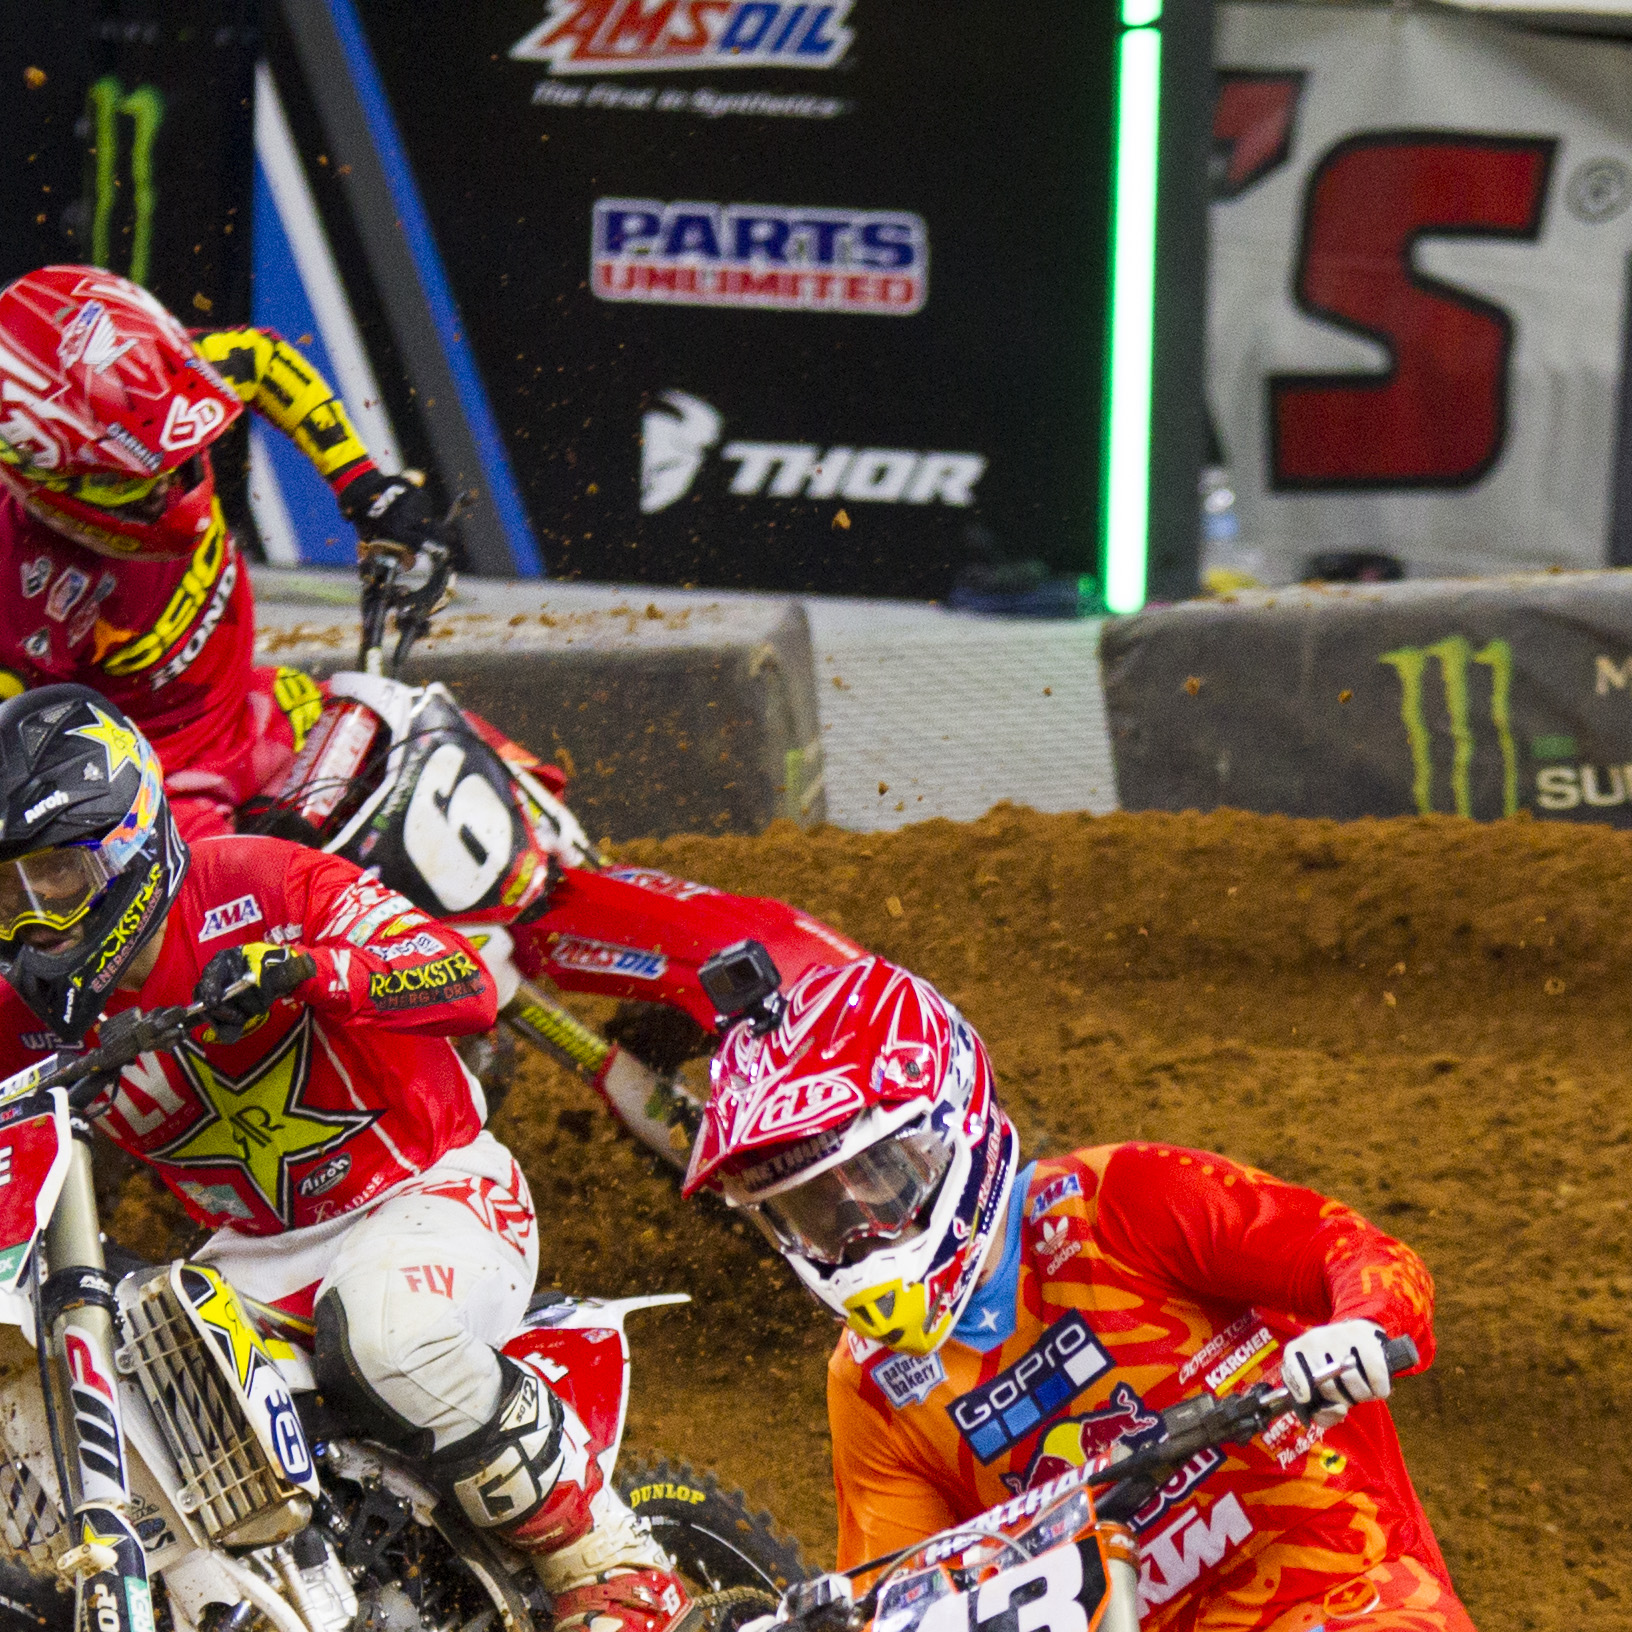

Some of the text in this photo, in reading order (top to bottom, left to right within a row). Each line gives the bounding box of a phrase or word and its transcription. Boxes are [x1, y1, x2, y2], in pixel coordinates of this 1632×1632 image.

[518, 0, 853, 70] AMSOIL
[604, 208, 916, 270] PARTS
[598, 260, 916, 307] UNLIMITED
[722, 440, 989, 505] THOR
[403, 744, 513, 912] 6
[202, 896, 262, 940] AMA
[299, 1154, 350, 1195] Airoh
[1046, 1240, 1081, 1276] adidas
[399, 1264, 455, 1300] FLY
[891, 1361, 937, 1398] bakery
[953, 1322, 1087, 1424] GoPro
[630, 1483, 706, 1509] DUNLOP
[1138, 1493, 1254, 1618] KTM
